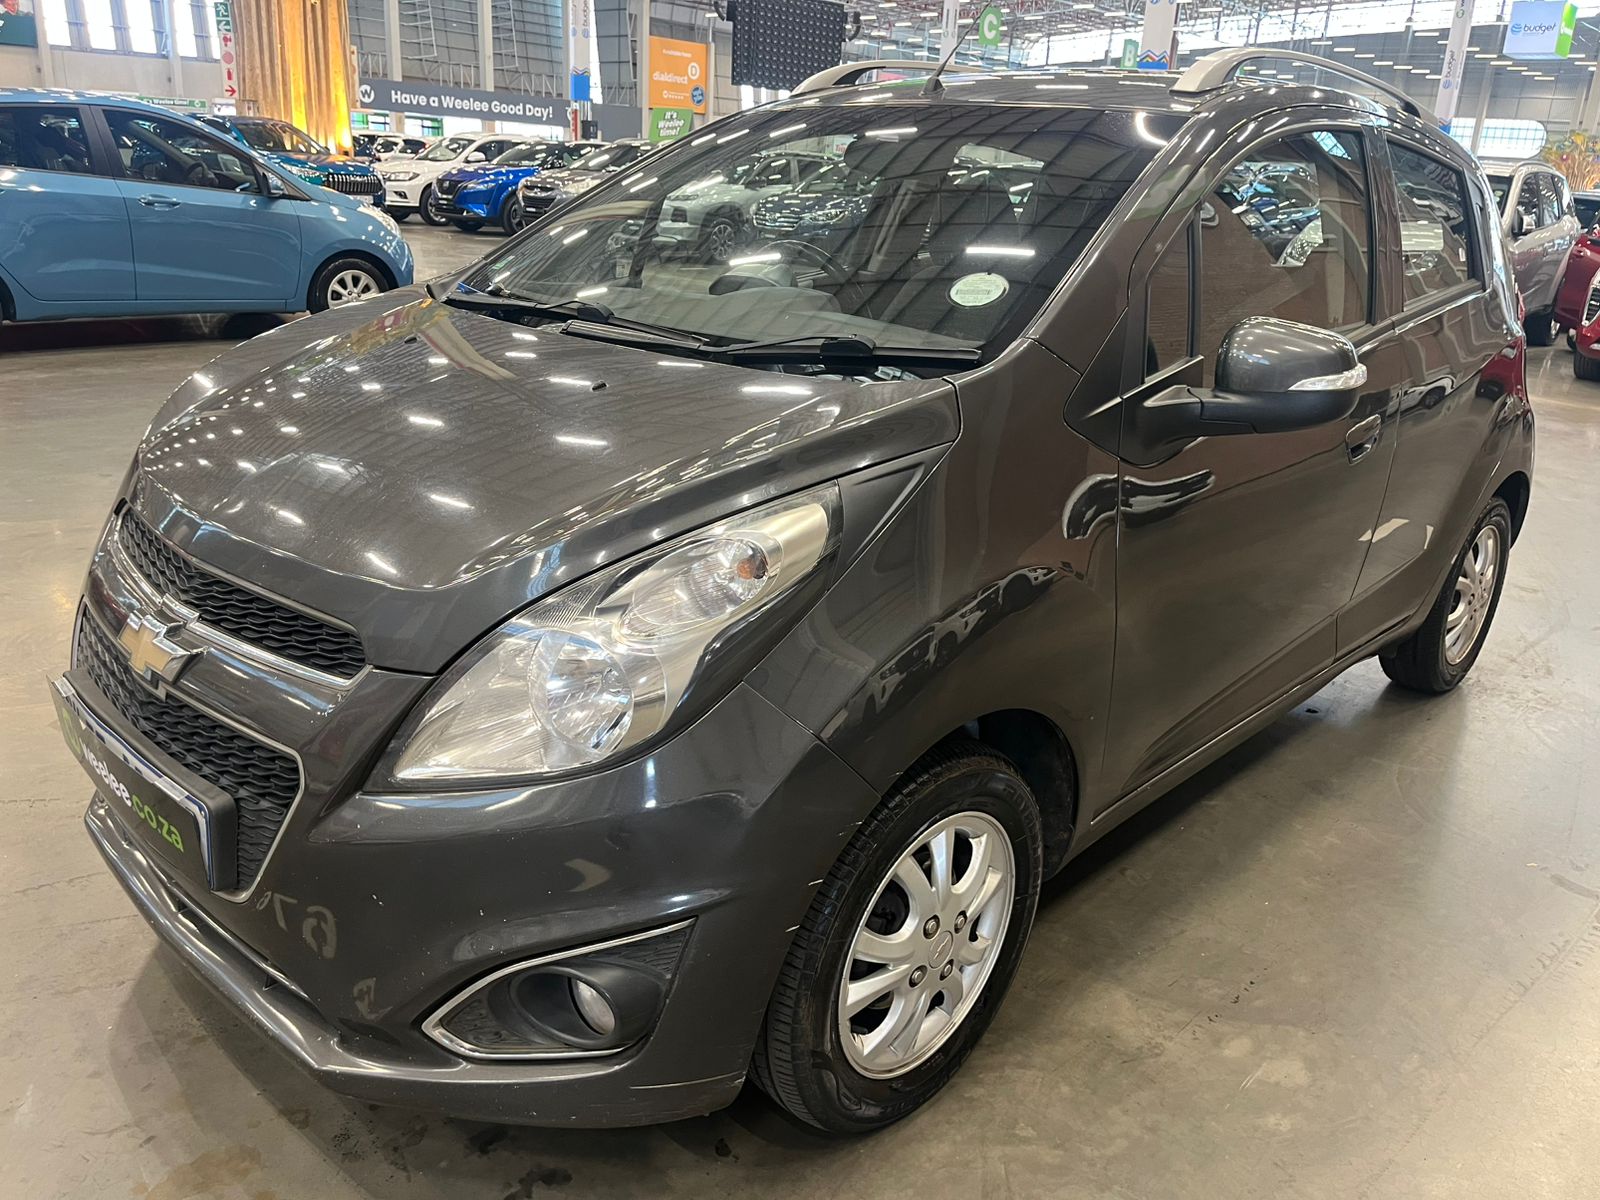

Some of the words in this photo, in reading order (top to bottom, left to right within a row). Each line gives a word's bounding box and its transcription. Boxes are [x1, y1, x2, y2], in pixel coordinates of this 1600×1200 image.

[983, 14, 998, 39] C
[1523, 22, 1556, 34] budget
[1124, 44, 1135, 67] B
[653, 72, 688, 84] dialdirect
[391, 90, 427, 106] Have
[429, 96, 439, 107] a
[441, 95, 489, 112] Weelee
[491, 101, 523, 115] Good
[525, 102, 553, 120] Day!
[664, 111, 677, 120] It's
[658, 119, 684, 130] Weelee
[660, 127, 680, 137] time!
[79, 738, 184, 853] weelee.co.za
